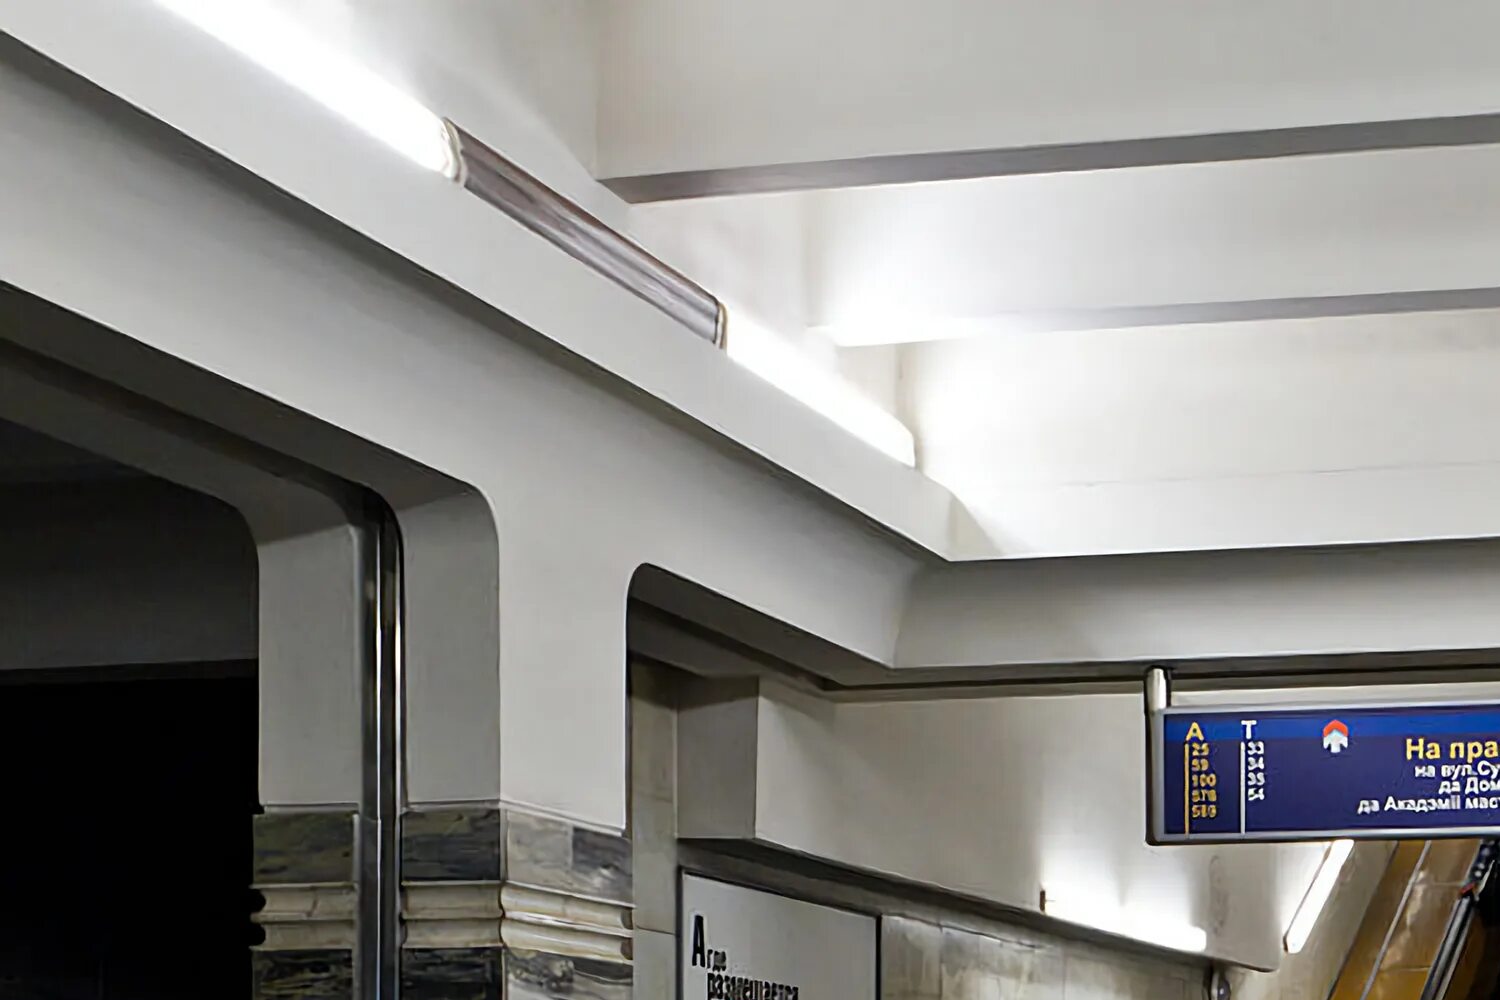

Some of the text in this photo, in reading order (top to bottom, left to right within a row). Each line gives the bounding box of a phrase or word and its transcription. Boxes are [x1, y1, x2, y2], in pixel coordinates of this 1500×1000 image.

[1406, 738, 1441, 760] На
[1438, 778, 1461, 795] да
[1357, 799, 1380, 815] да
[691, 914, 706, 968] А
